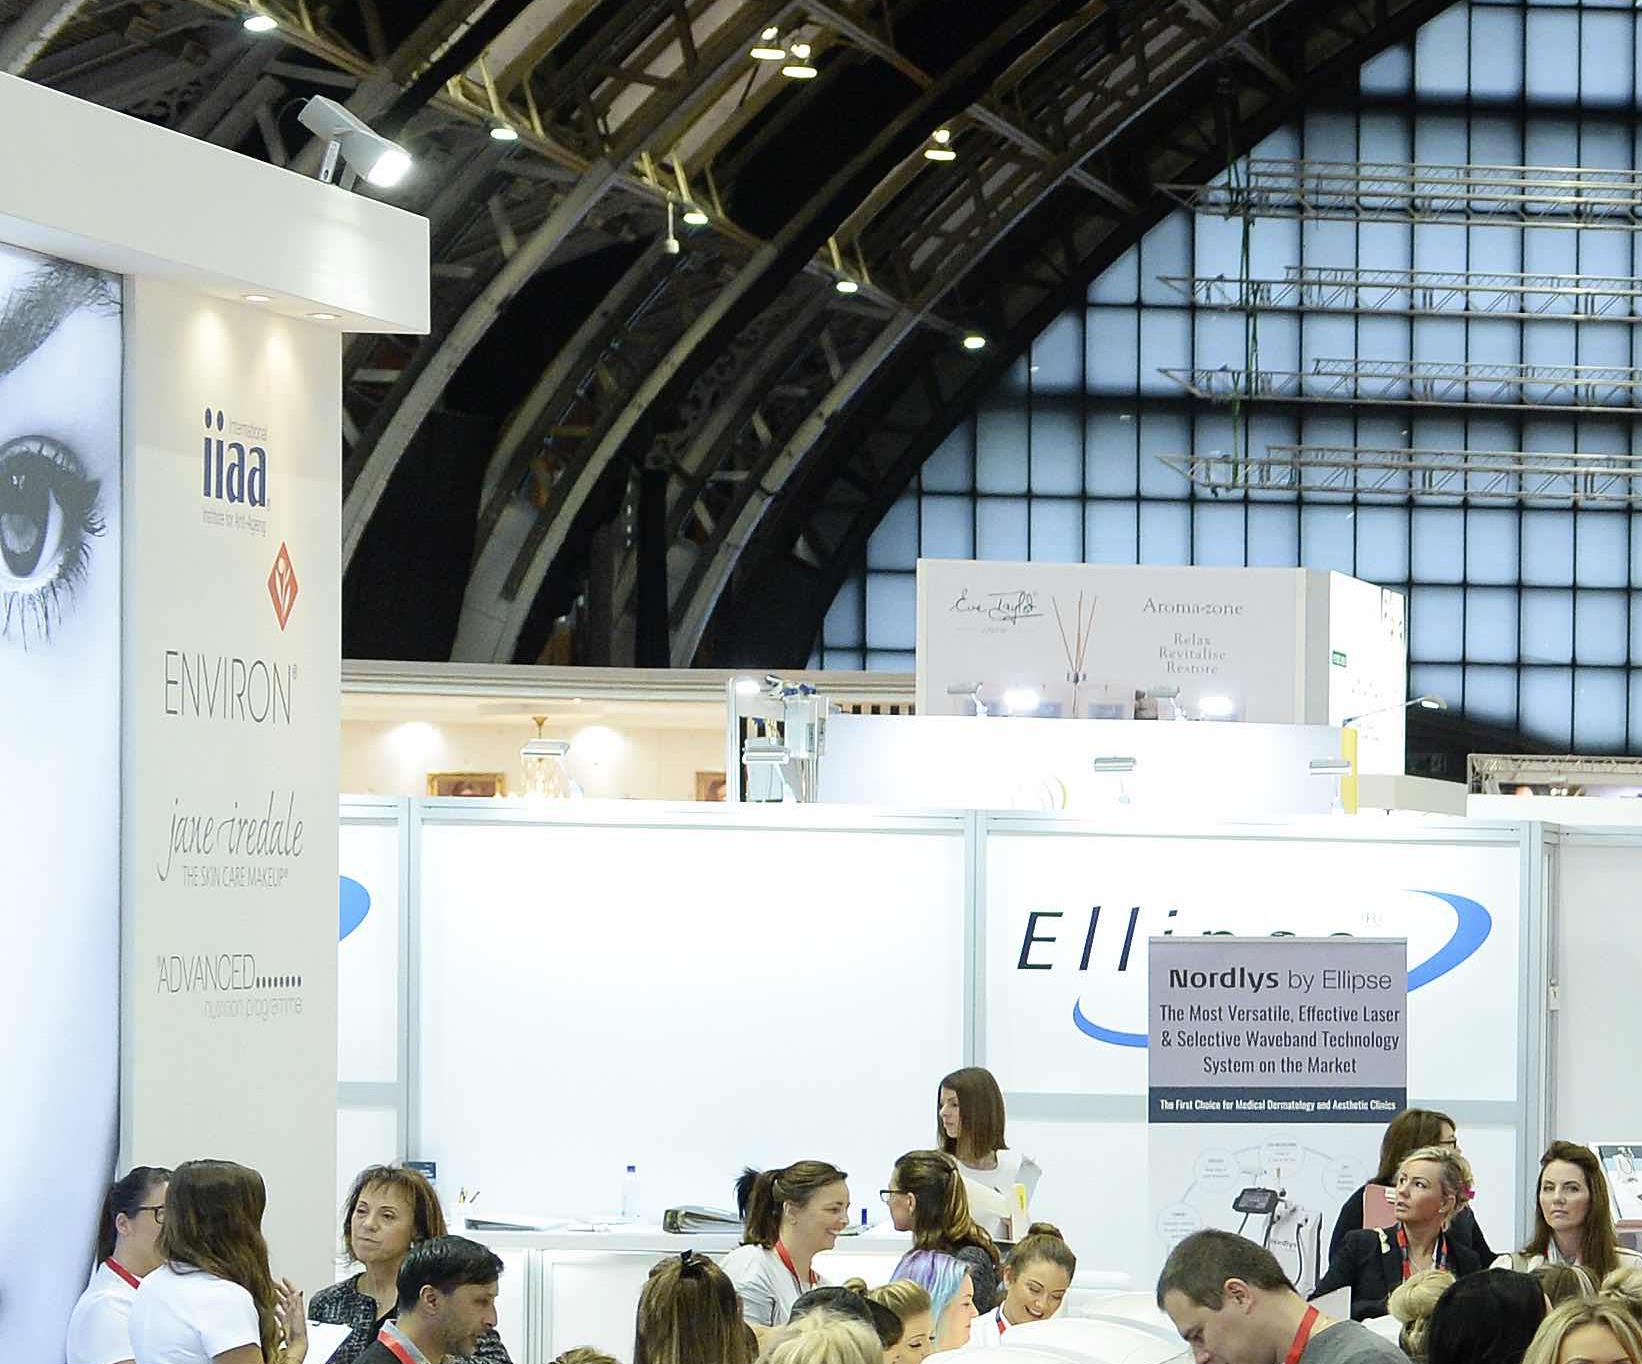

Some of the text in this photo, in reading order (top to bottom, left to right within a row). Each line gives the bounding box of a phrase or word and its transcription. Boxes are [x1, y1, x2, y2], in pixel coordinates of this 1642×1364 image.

[203, 407, 267, 508] iiaa
[1143, 597, 1244, 616] Aroma-zone
[1174, 632, 1211, 646] Relax
[1159, 646, 1226, 660] Revitalise
[1166, 660, 1218, 674] Restore
[1169, 967, 1393, 993] Nordlys by Ellipse
[1160, 1005, 1400, 1023] The Most Versatile, Effective Laser
[1161, 1031, 1400, 1051] & Selective Waveband Technology
[1203, 1057, 1358, 1075] System on the Market
[1160, 1099, 1397, 1112] The First Choice for Medical Dermatology and Aesthetic Clinics
